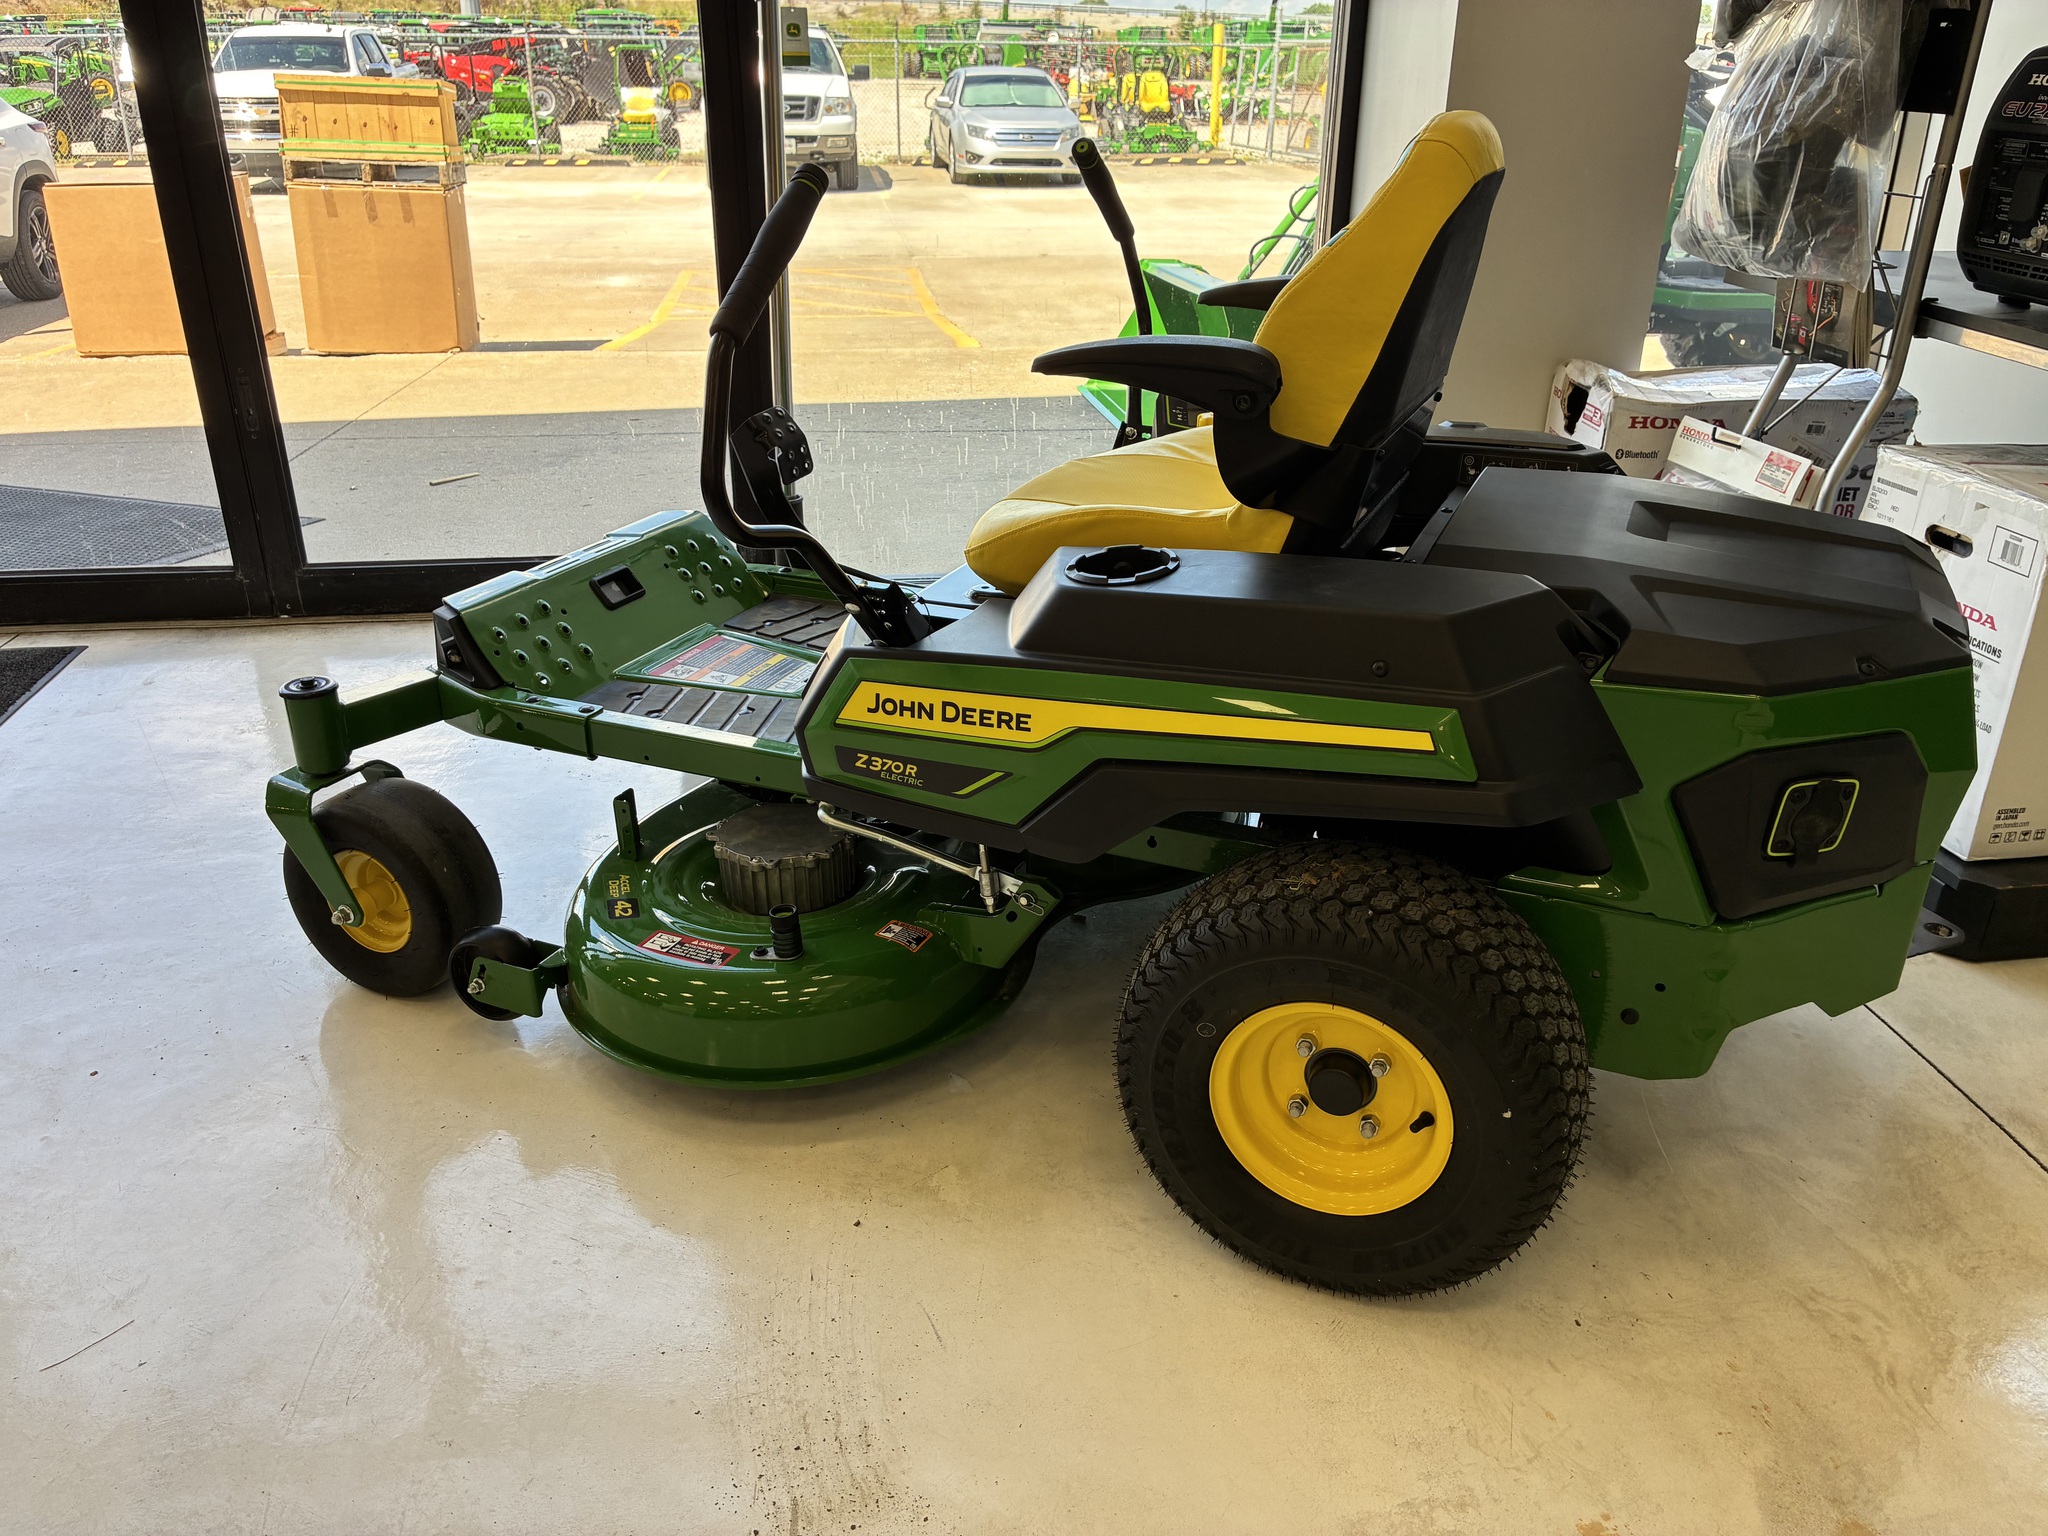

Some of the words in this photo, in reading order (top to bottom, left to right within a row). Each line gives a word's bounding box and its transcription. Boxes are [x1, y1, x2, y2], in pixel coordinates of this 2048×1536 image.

[1628, 416, 1727, 430] HONA
[1680, 434, 1714, 450] GENERATORS
[1682, 426, 1713, 443] HOND
[1624, 450, 1659, 459] Bluetooth
[1968, 635, 2002, 659] ICATIONS
[867, 693, 934, 721] JOHN
[941, 701, 1032, 732] DEERE
[880, 771, 924, 787] ELECTRIC
[1997, 807, 2026, 815] ASSEMBLED
[609, 880, 619, 898] DEEP
[619, 874, 630, 895] ACCEL
[614, 901, 633, 917] 42
[699, 940, 725, 951] DANGER
